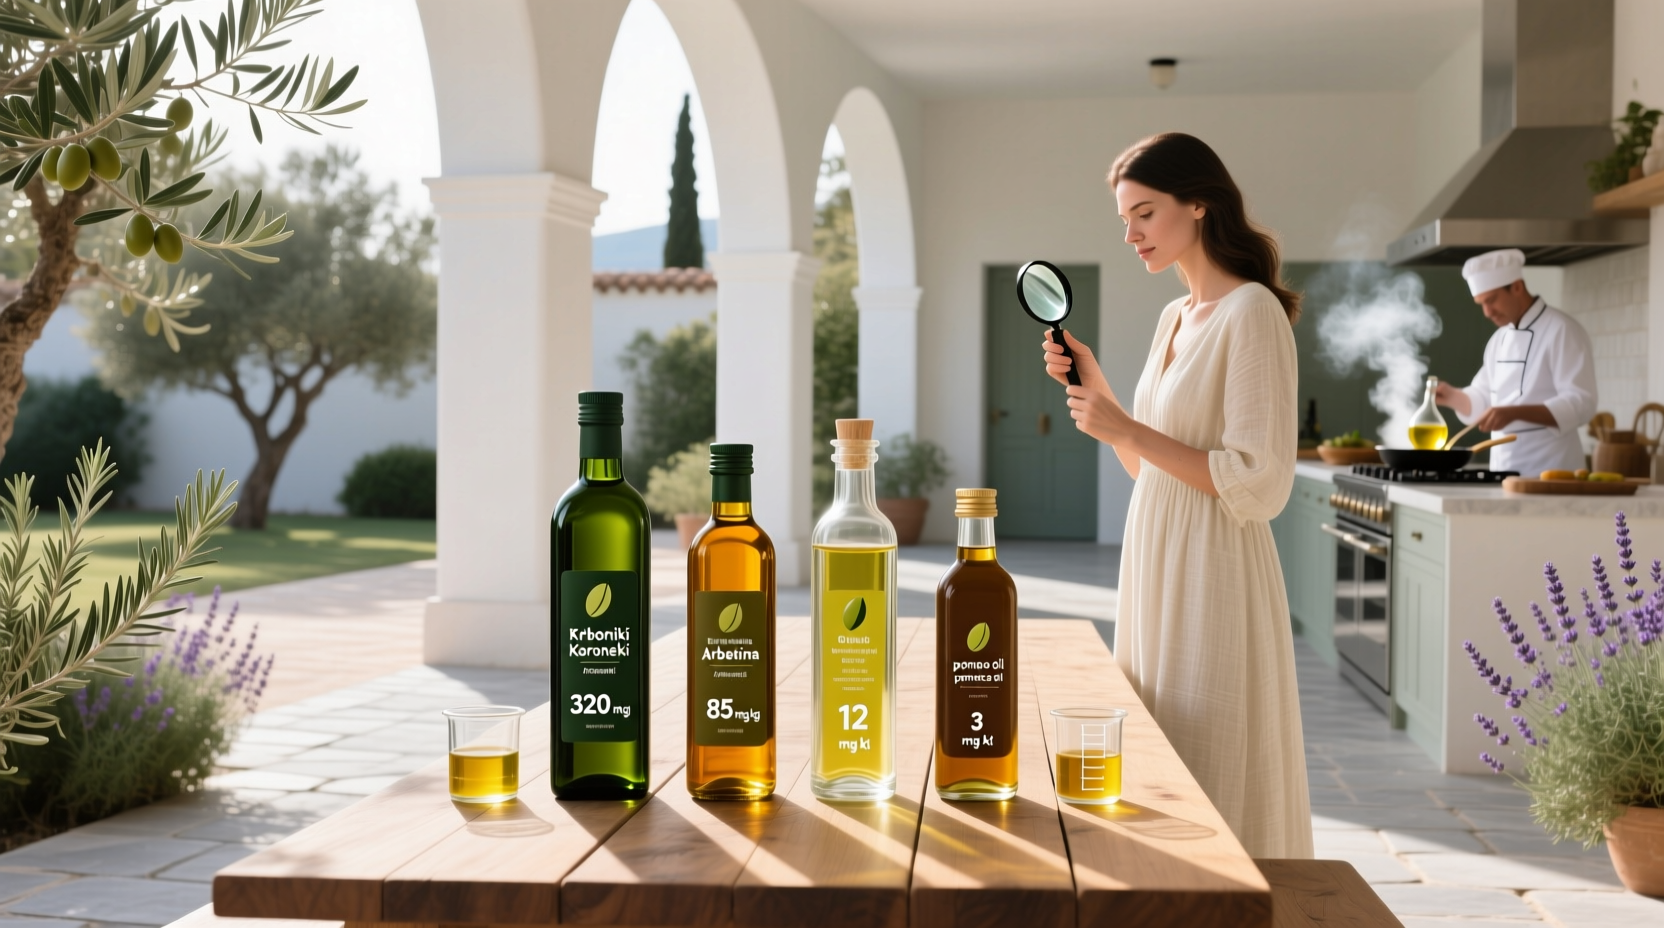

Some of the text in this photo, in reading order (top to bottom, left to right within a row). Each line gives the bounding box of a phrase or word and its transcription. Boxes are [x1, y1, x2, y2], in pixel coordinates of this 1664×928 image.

[569, 642, 630, 657] Koroneki
[701, 645, 760, 661] Arbetina
[570, 693, 631, 718] 320 mg
[706, 698, 734, 720] 85
[838, 704, 869, 731] 12
[970, 711, 984, 732] 3
[838, 740, 858, 754] mg
[962, 737, 981, 750] mg
